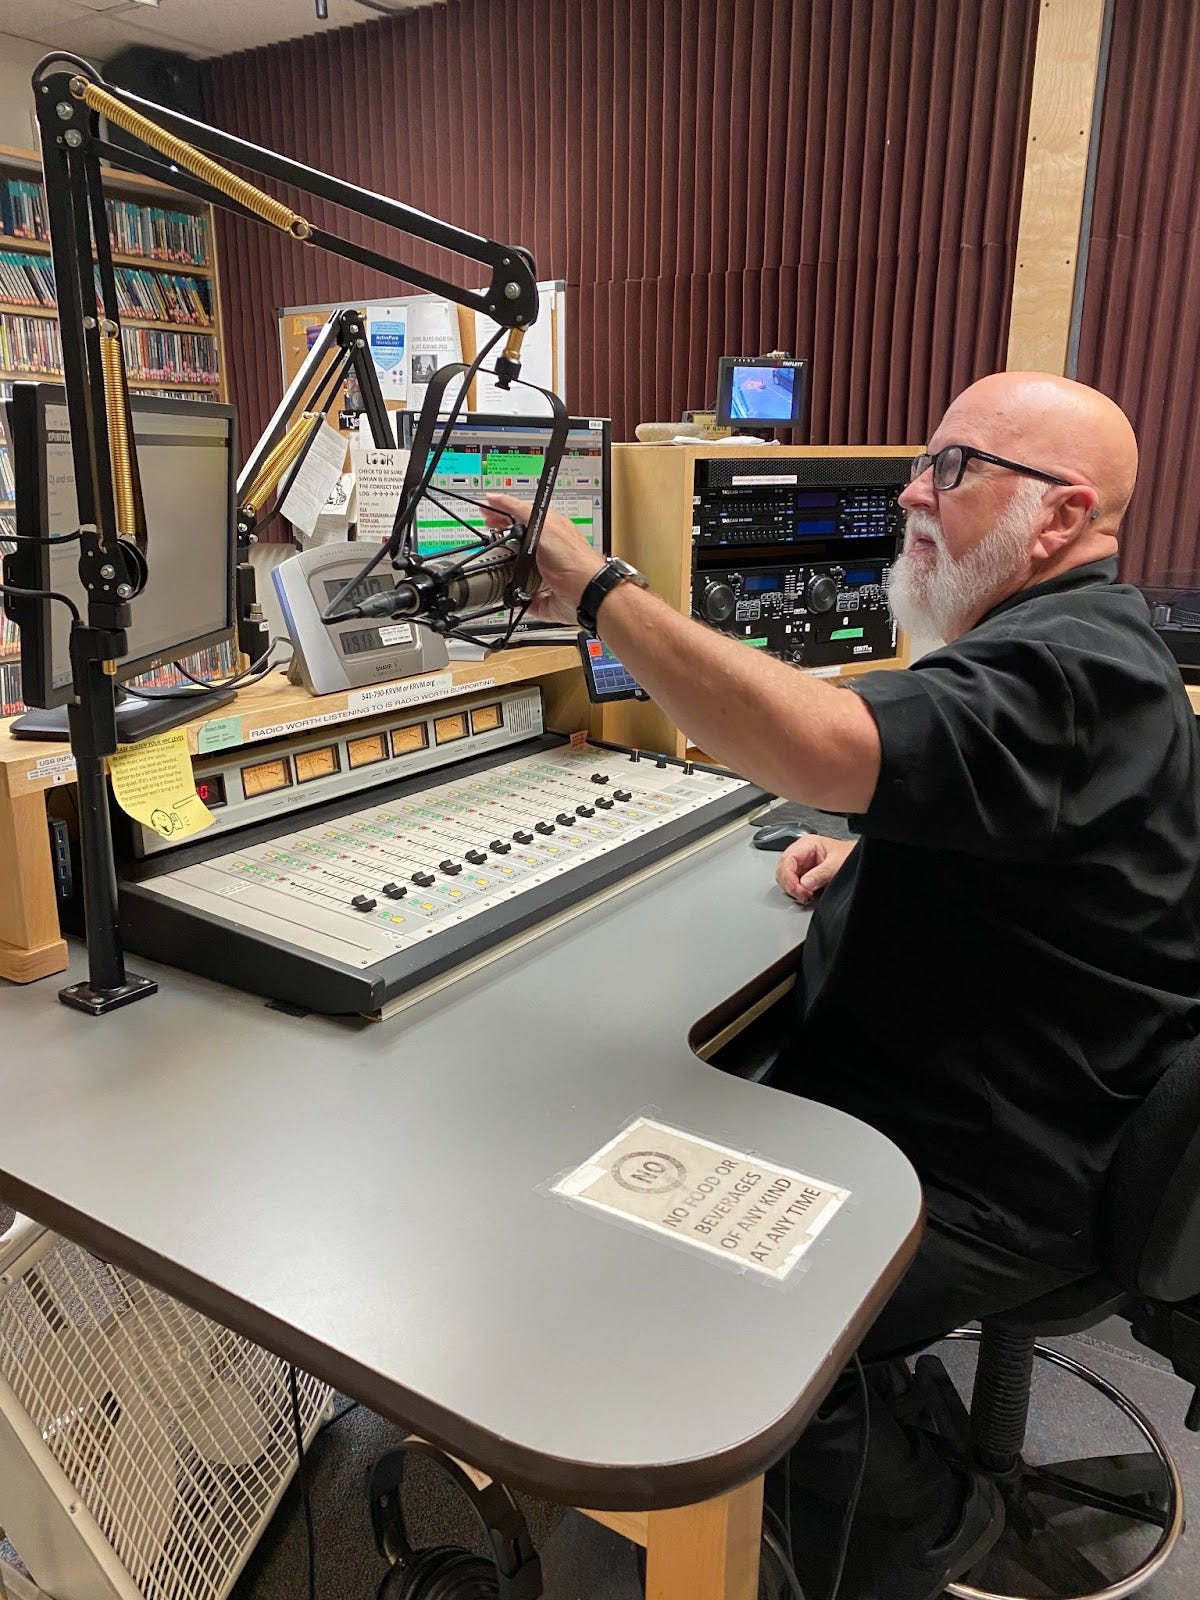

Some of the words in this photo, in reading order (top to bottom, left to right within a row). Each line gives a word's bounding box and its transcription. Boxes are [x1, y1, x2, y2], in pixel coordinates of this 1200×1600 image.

[366, 452, 394, 466] LOOK
[251, 725, 284, 738] RADIO
[286, 717, 322, 729] WORTH
[324, 707, 370, 722] LISTENING
[395, 696, 420, 706] RADIO
[422, 690, 449, 700] WORTH
[450, 679, 495, 694] SUPPORTING
[361, 686, 402, 700] 541-790-KRVM
[409, 679, 435, 691] KRVM.org
[631, 1161, 666, 1184] NO
[662, 1206, 690, 1227] NO
[684, 1176, 720, 1208] FOOD
[715, 1159, 739, 1181] OR
[694, 1172, 761, 1235] BEVERAGES
[720, 1228, 743, 1250] OF
[744, 1204, 766, 1233] ANY
[760, 1176, 792, 1214] KIND
[750, 1242, 772, 1262] AT
[768, 1216, 797, 1245] ANY
[787, 1187, 821, 1218] TIME
